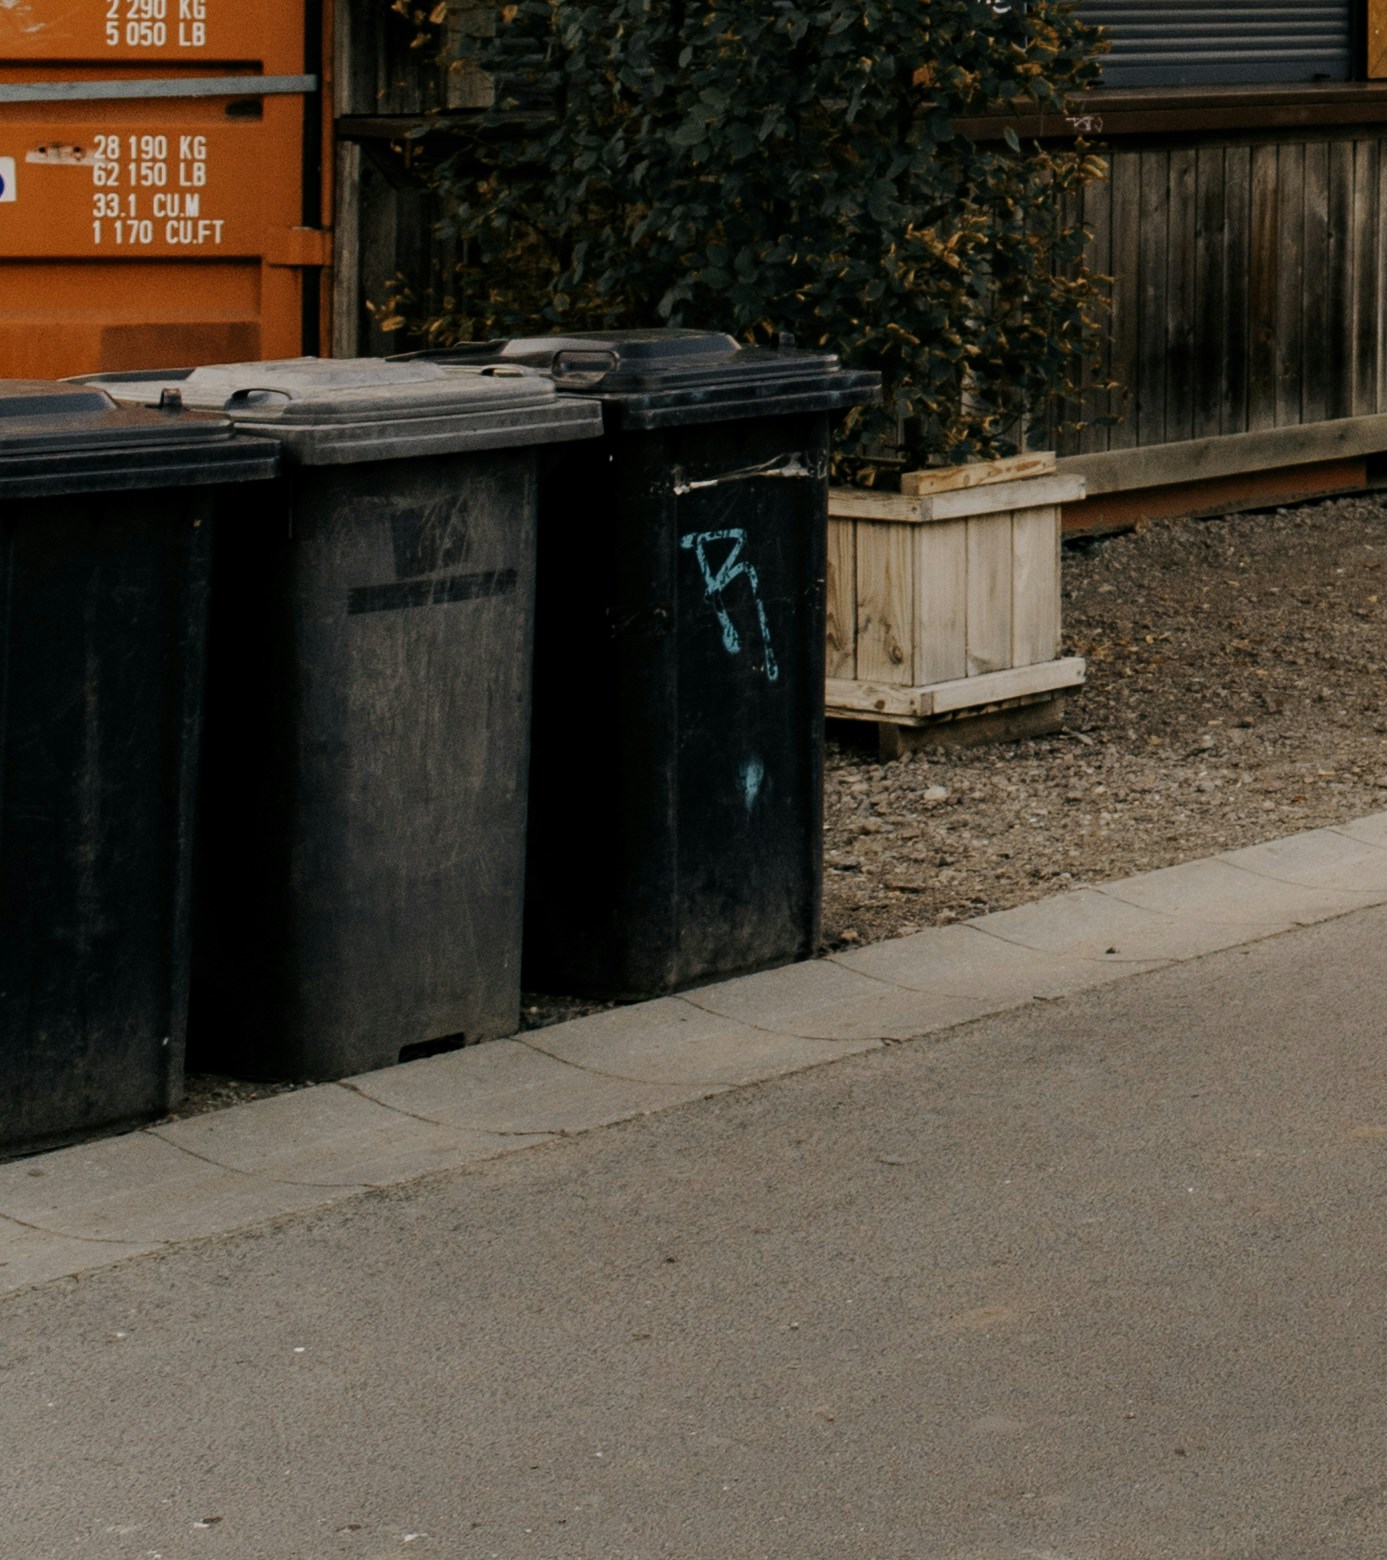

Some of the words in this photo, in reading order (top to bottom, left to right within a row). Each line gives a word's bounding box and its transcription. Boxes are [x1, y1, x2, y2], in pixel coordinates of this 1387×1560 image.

[106, 22, 119, 46] 5
[126, 22, 167, 46] 050
[179, 22, 207, 46] LB
[93, 135, 120, 160] 28
[129, 135, 168, 160] 190
[180, 136, 207, 160] KG
[93, 162, 120, 186] 62
[129, 162, 167, 186] 150
[180, 162, 207, 186] LB
[93, 193, 137, 218] 33.1
[153, 193, 200, 218] CU.M
[93, 220, 102, 244] 1
[115, 220, 154, 244] 170
[166, 220, 225, 244] CU.FT
